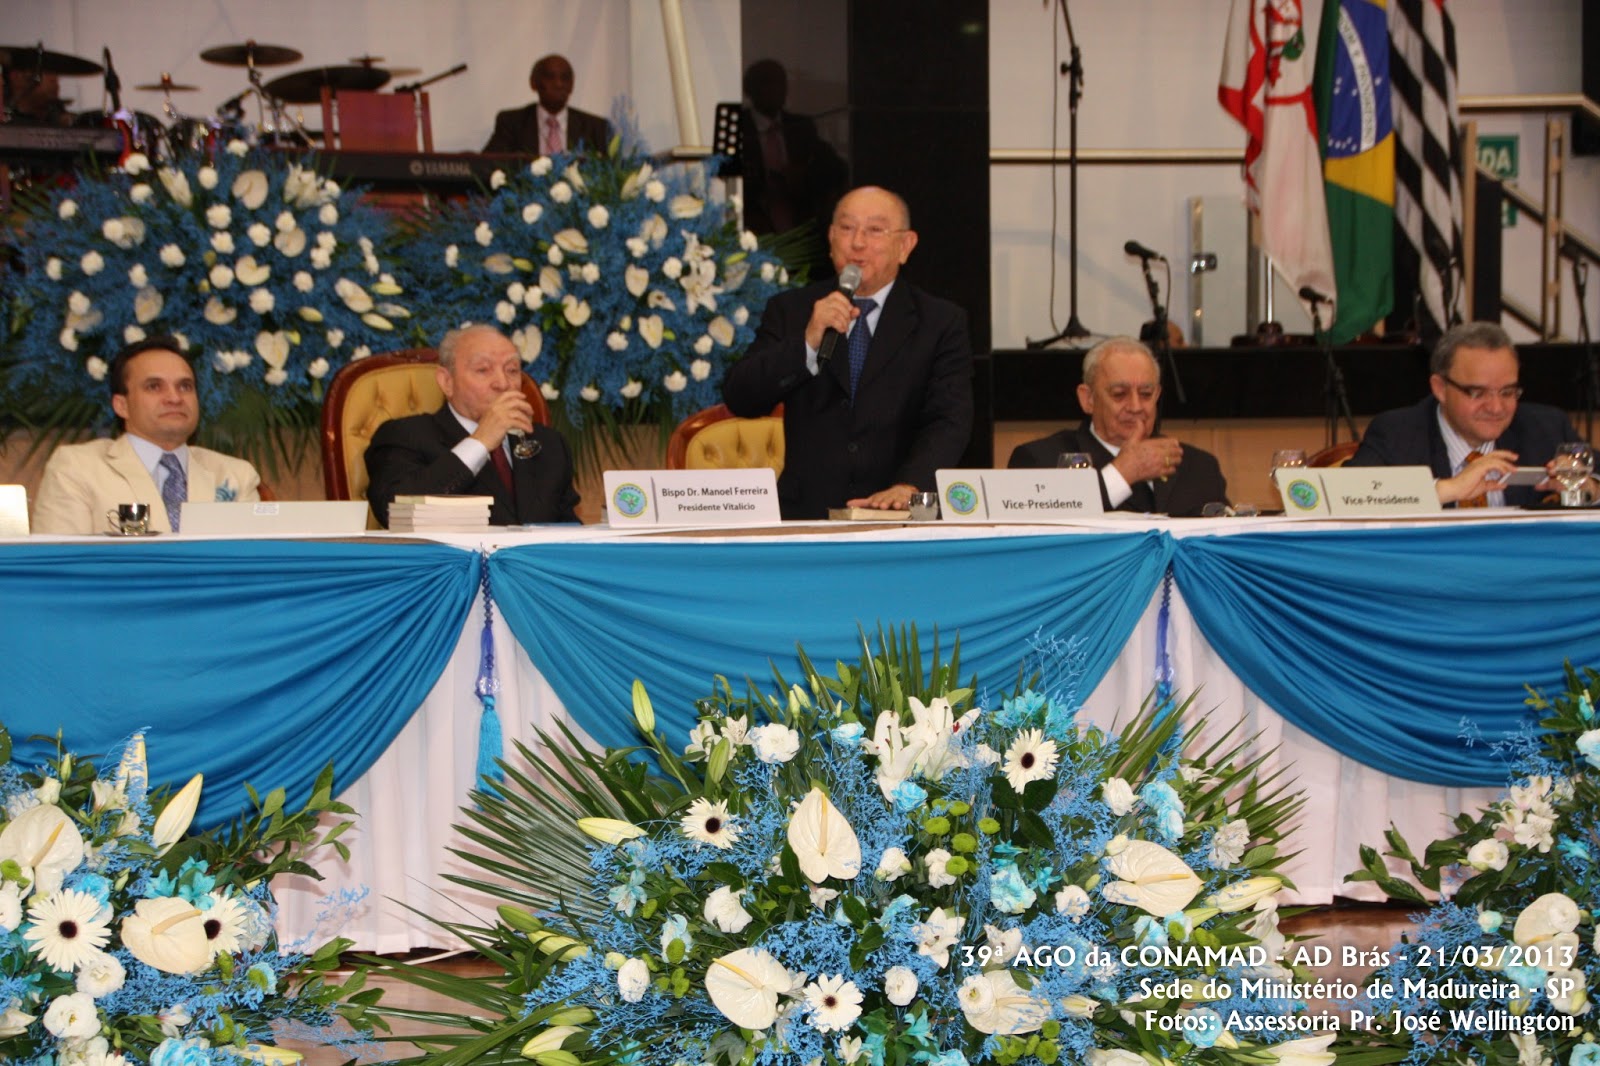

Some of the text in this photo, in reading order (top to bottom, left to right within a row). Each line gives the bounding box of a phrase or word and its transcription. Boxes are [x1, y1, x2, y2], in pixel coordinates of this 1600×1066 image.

[424, 161, 471, 175] YAMAHA
[661, 486, 768, 498] Bispo Dr. Manoel Ferreira
[1001, 499, 1084, 510] Vice-Presidente
[1342, 494, 1420, 506] Vice-Presidente
[678, 503, 721, 512] Presidente
